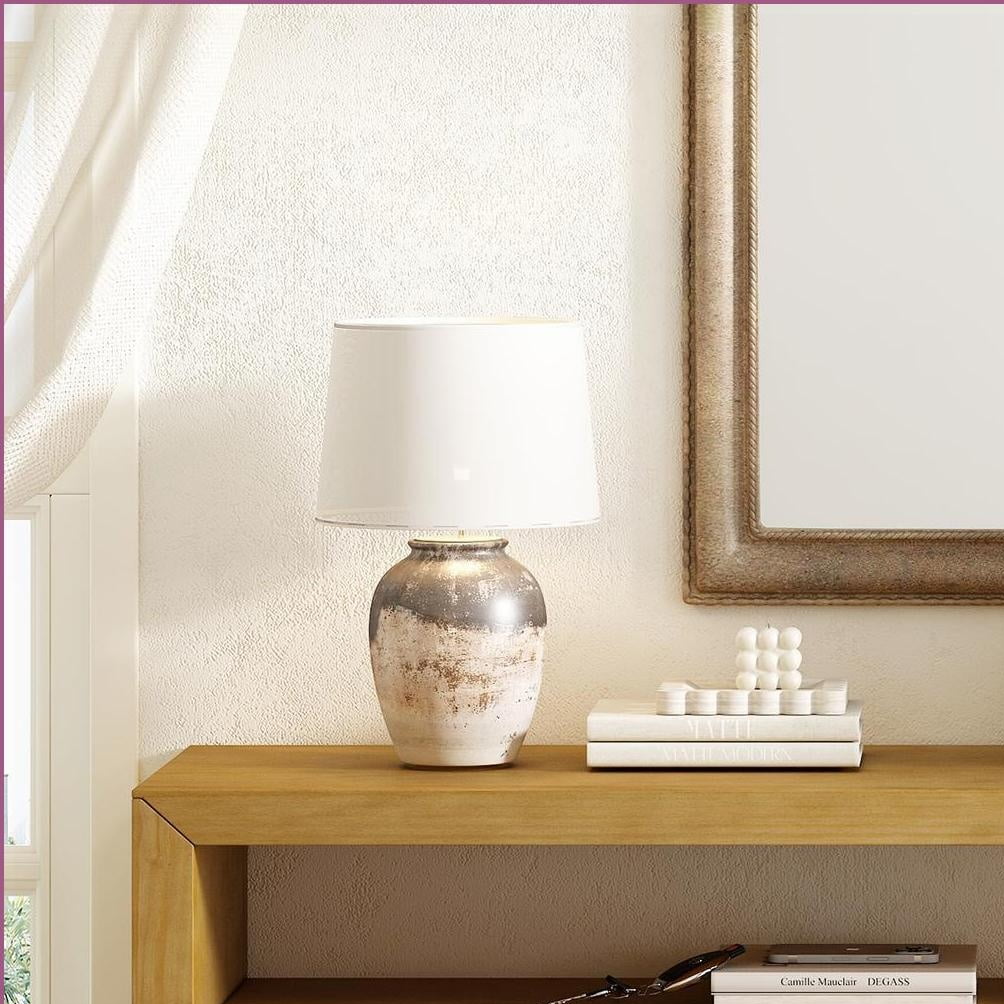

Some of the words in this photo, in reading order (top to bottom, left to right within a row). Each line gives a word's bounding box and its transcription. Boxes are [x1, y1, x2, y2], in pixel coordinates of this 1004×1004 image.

[780, 977, 816, 986] Camille
[817, 977, 858, 986] Mauclair
[867, 977, 911, 986] DEGASS
